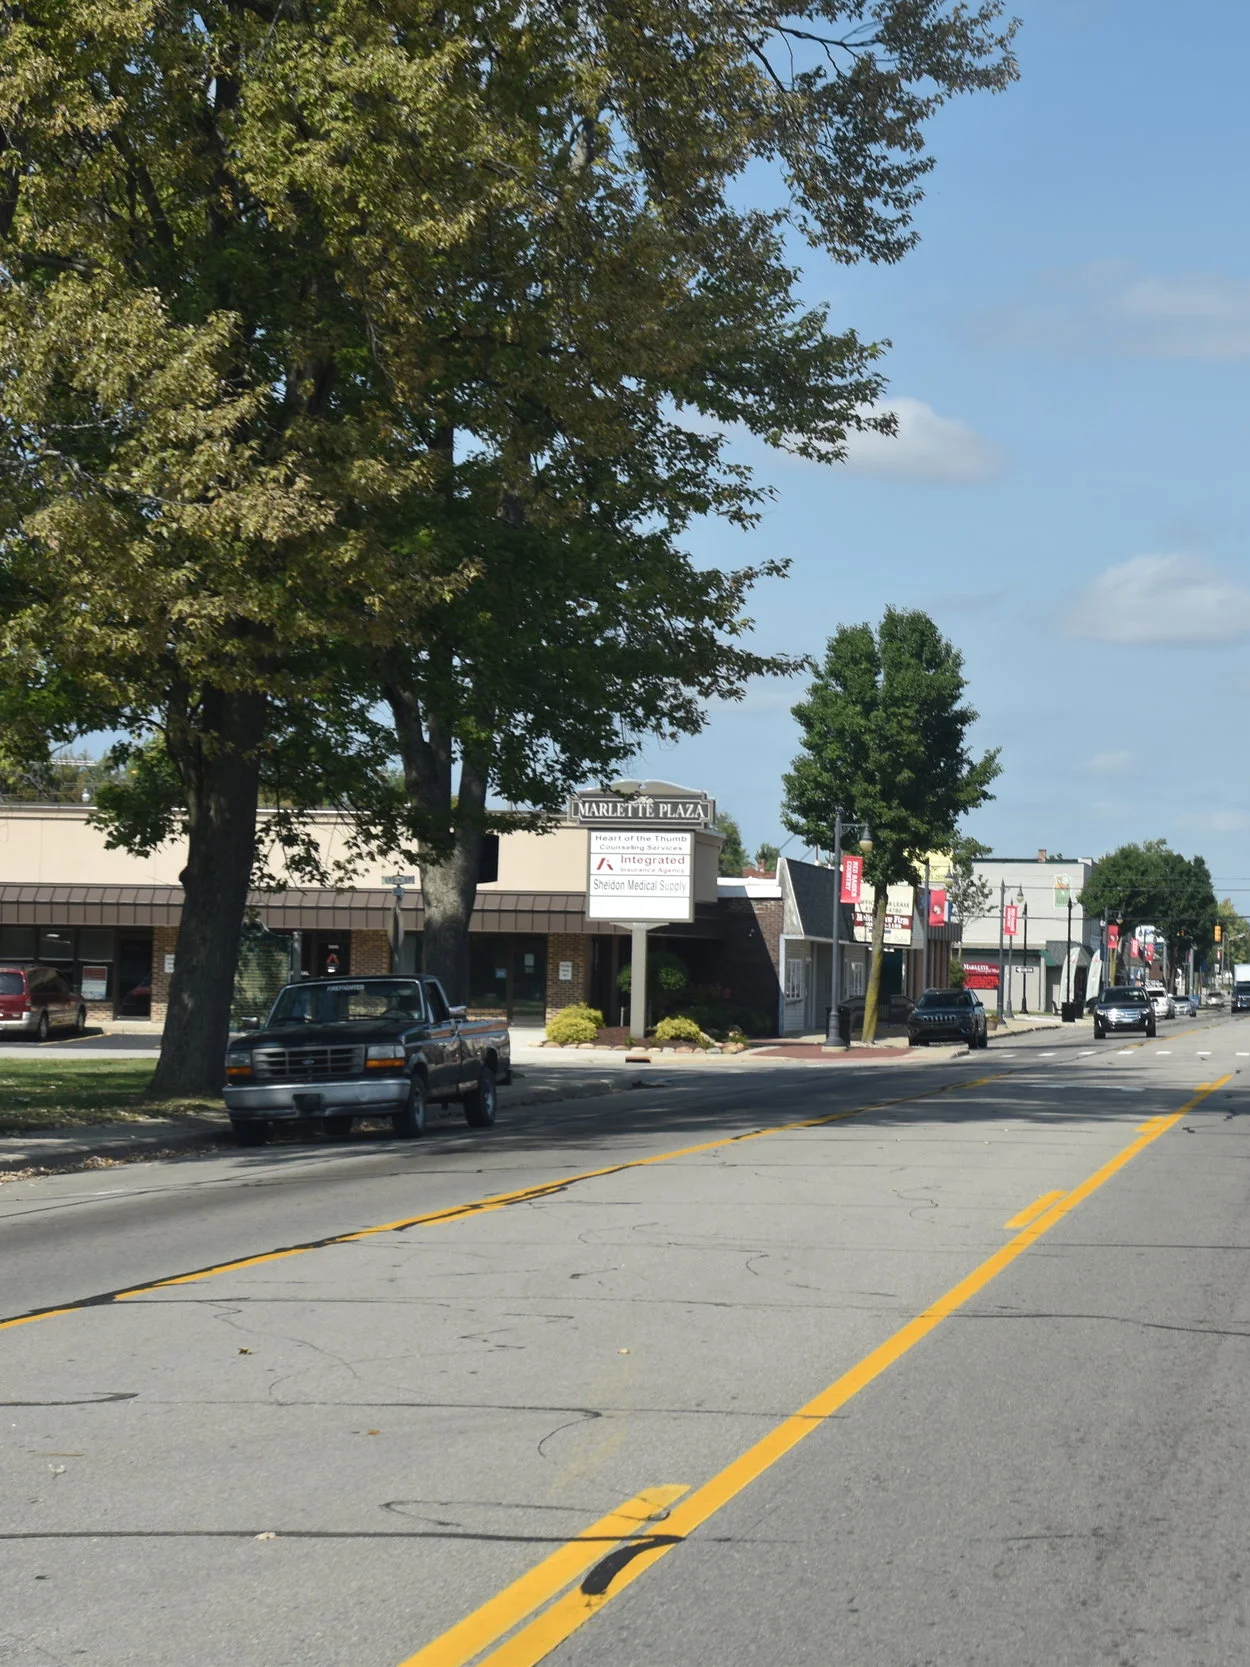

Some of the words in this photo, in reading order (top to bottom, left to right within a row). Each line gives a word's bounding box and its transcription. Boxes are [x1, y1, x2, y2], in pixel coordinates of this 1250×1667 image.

[578, 802, 655, 817] MARLETTE
[659, 803, 705, 818] PLAZA
[621, 854, 685, 866] Integrated
[845, 860, 853, 892] COUNTRY
[593, 878, 625, 890] Sheldon
[627, 880, 658, 891] Medical
[659, 880, 686, 894] Supply
[326, 984, 365, 992] FIREFIGHTER
